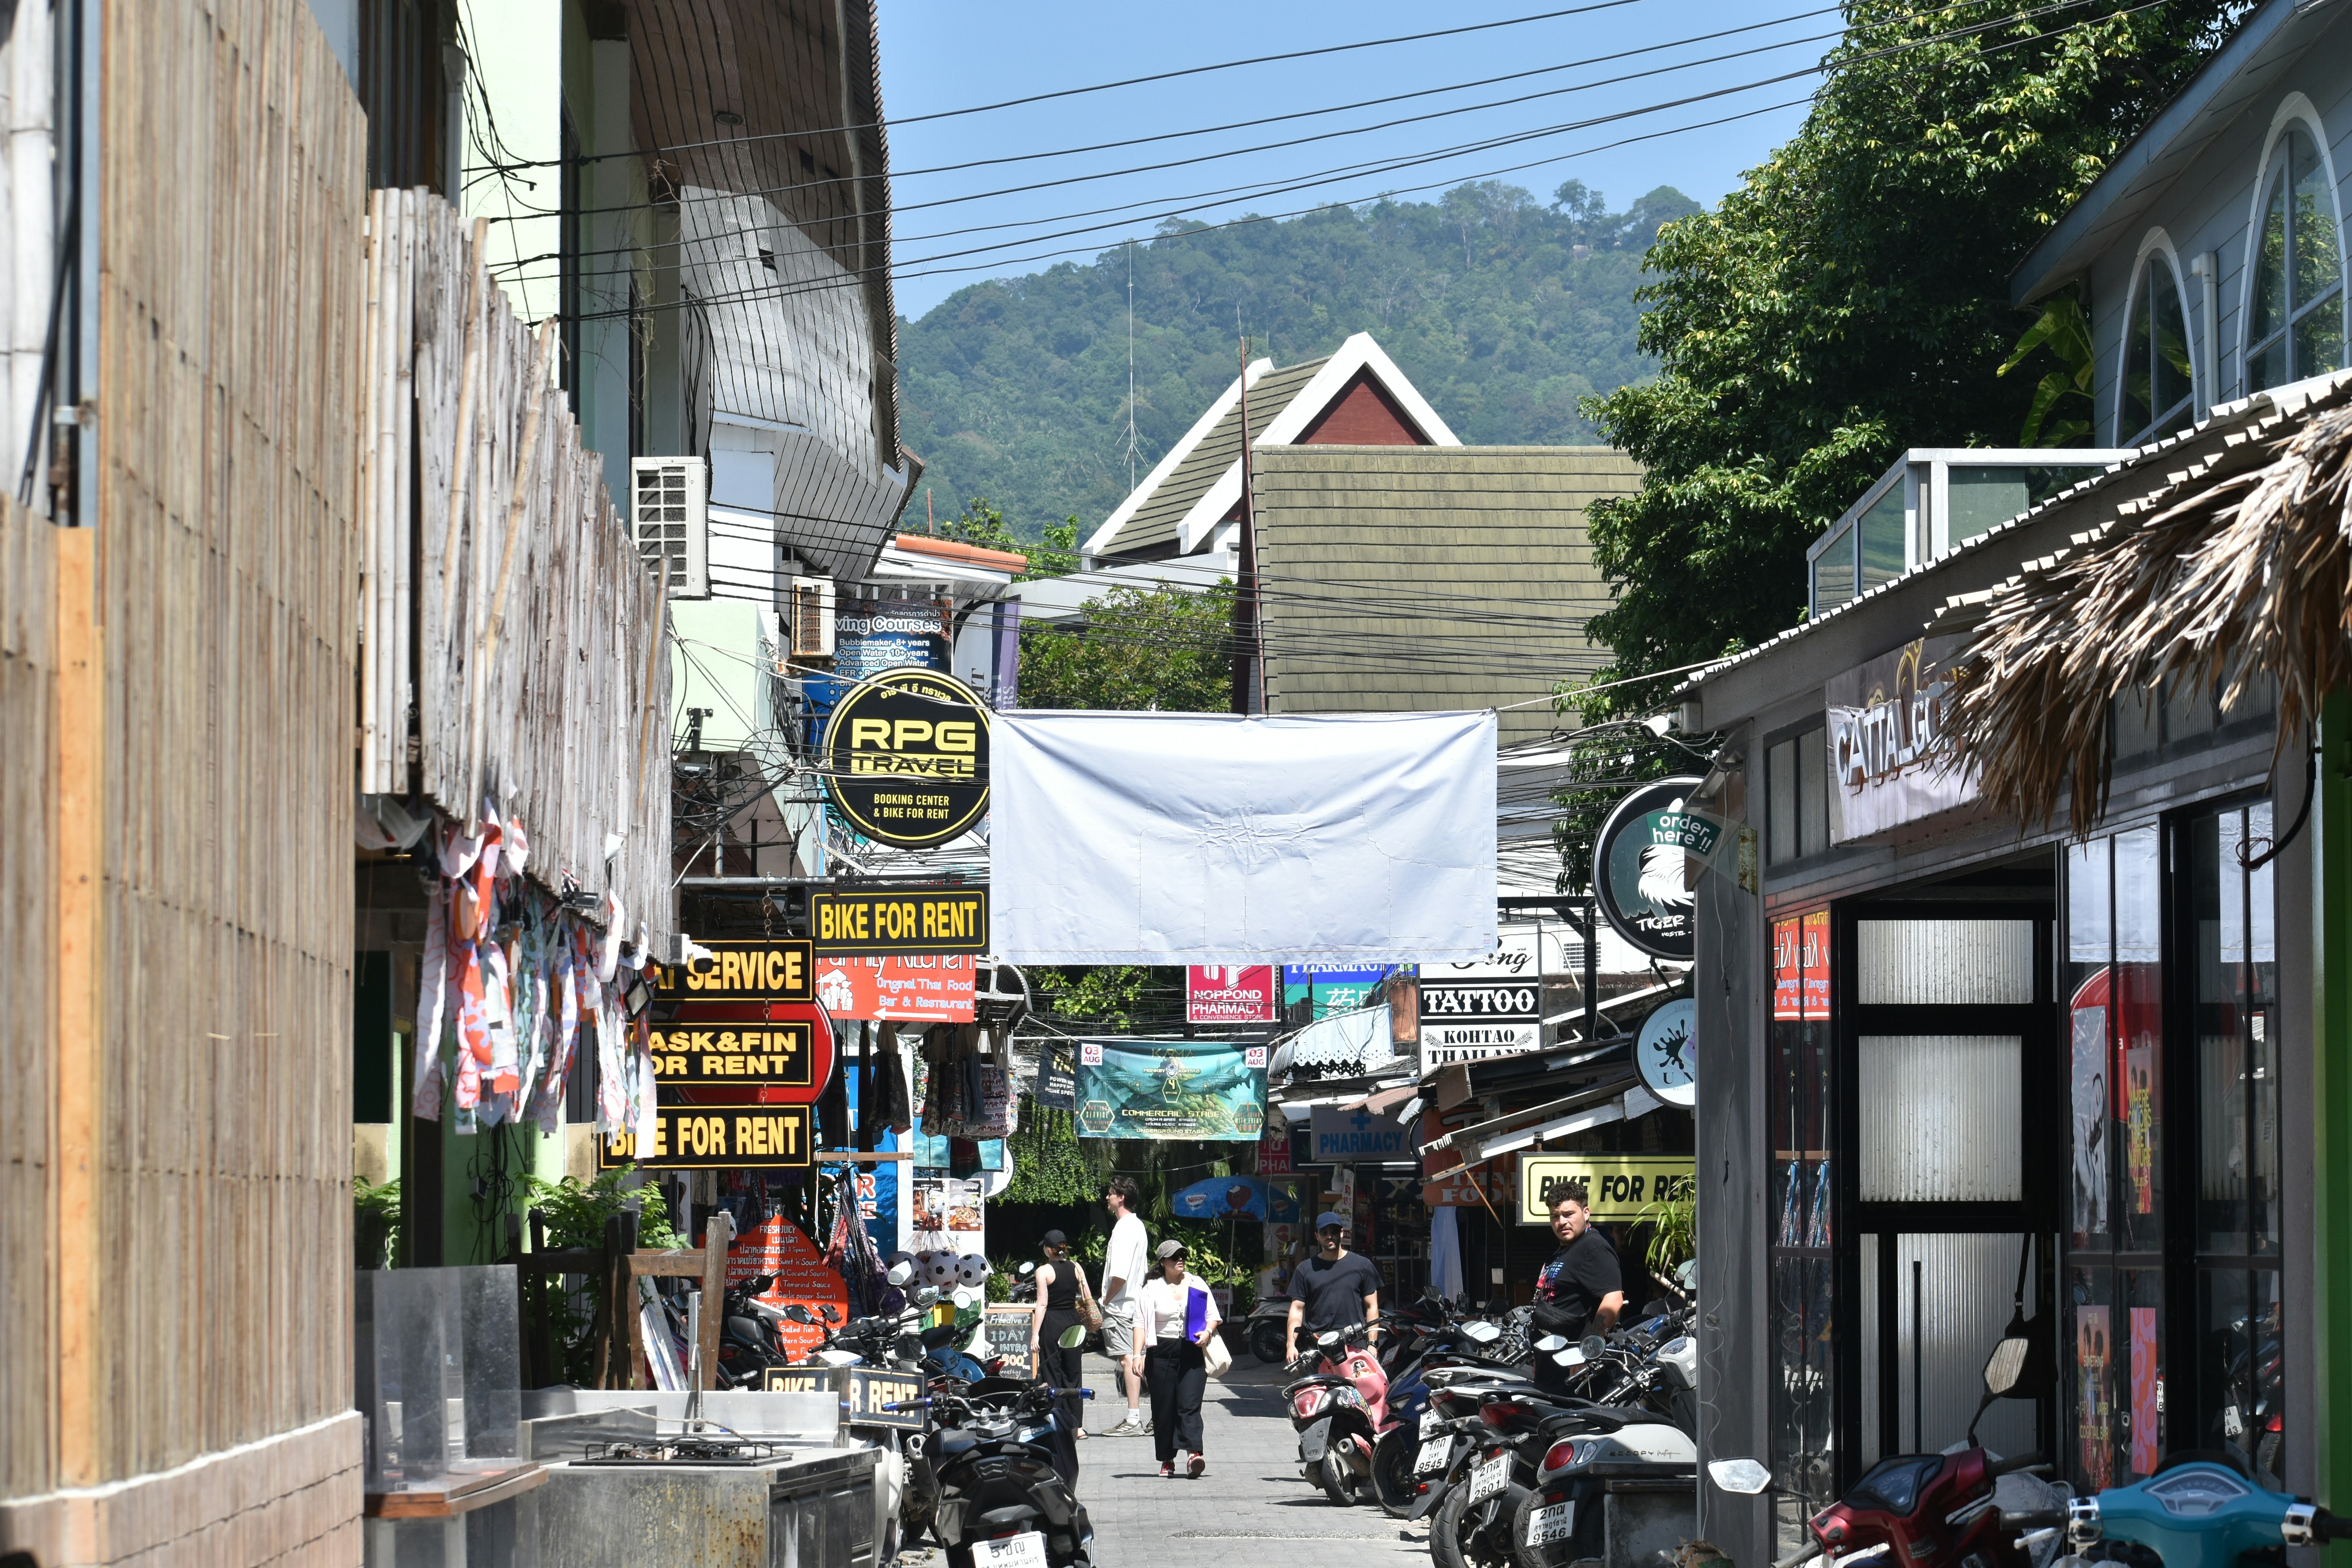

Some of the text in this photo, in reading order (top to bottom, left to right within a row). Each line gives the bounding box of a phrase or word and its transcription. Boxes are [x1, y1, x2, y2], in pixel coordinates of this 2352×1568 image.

[873, 616, 942, 632] Courses
[882, 660, 903, 668] Open
[852, 719, 976, 752] RPG
[851, 755, 975, 775] TRAVEL
[874, 794, 949, 806] BOOKING CENTER
[874, 808, 949, 819] & BIKE FOR RENT
[1659, 813, 1710, 837] order
[1653, 828, 1695, 845] here
[821, 902, 977, 939] BIKE FOR RENT
[1635, 915, 1685, 931] TIGER
[877, 977, 972, 993] Original Thai Food
[879, 995, 973, 1009] Bar & Restaurant
[1194, 990, 1262, 999] NOPPOND
[1424, 989, 1535, 1013] TATTOO
[1192, 1002, 1264, 1014] PHARMACY
[630, 1032, 796, 1052] ASK&FIN
[1444, 1030, 1515, 1044] KOHTAO
[1085, 1047, 1099, 1055] 03
[1152, 1048, 1195, 1059] KARMA
[1249, 1049, 1263, 1057] 03
[703, 1056, 789, 1074] RENT
[1168, 1080, 1175, 1089] 4
[2128, 1089, 2150, 1109] WHERE
[2127, 1108, 2152, 1130] COLORS
[611, 1116, 799, 1156] BIE FOR RENT
[1320, 1131, 1403, 1154] PHARMACY
[2131, 1129, 2148, 1148] MEET
[2128, 1147, 2152, 1168] NATURE
[1539, 1175, 1591, 1202] BE
[1600, 1175, 1645, 1202] FOR
[801, 1258, 818, 1266] Sour)
[779, 1280, 809, 1288] (Tamarind
[774, 1290, 795, 1298] (Garlic
[990, 1314, 1022, 1324] Freedive
[1000, 1343, 1027, 1352] INTRO
[2083, 1355, 2103, 1367] SOMETHING
[869, 1380, 918, 1417] RENT
[2100, 1426, 2109, 1440] BAR
[1418, 1458, 1443, 1472] 9545
[1474, 1479, 1500, 1500] 2801
[1533, 1527, 1566, 1543] 9546
